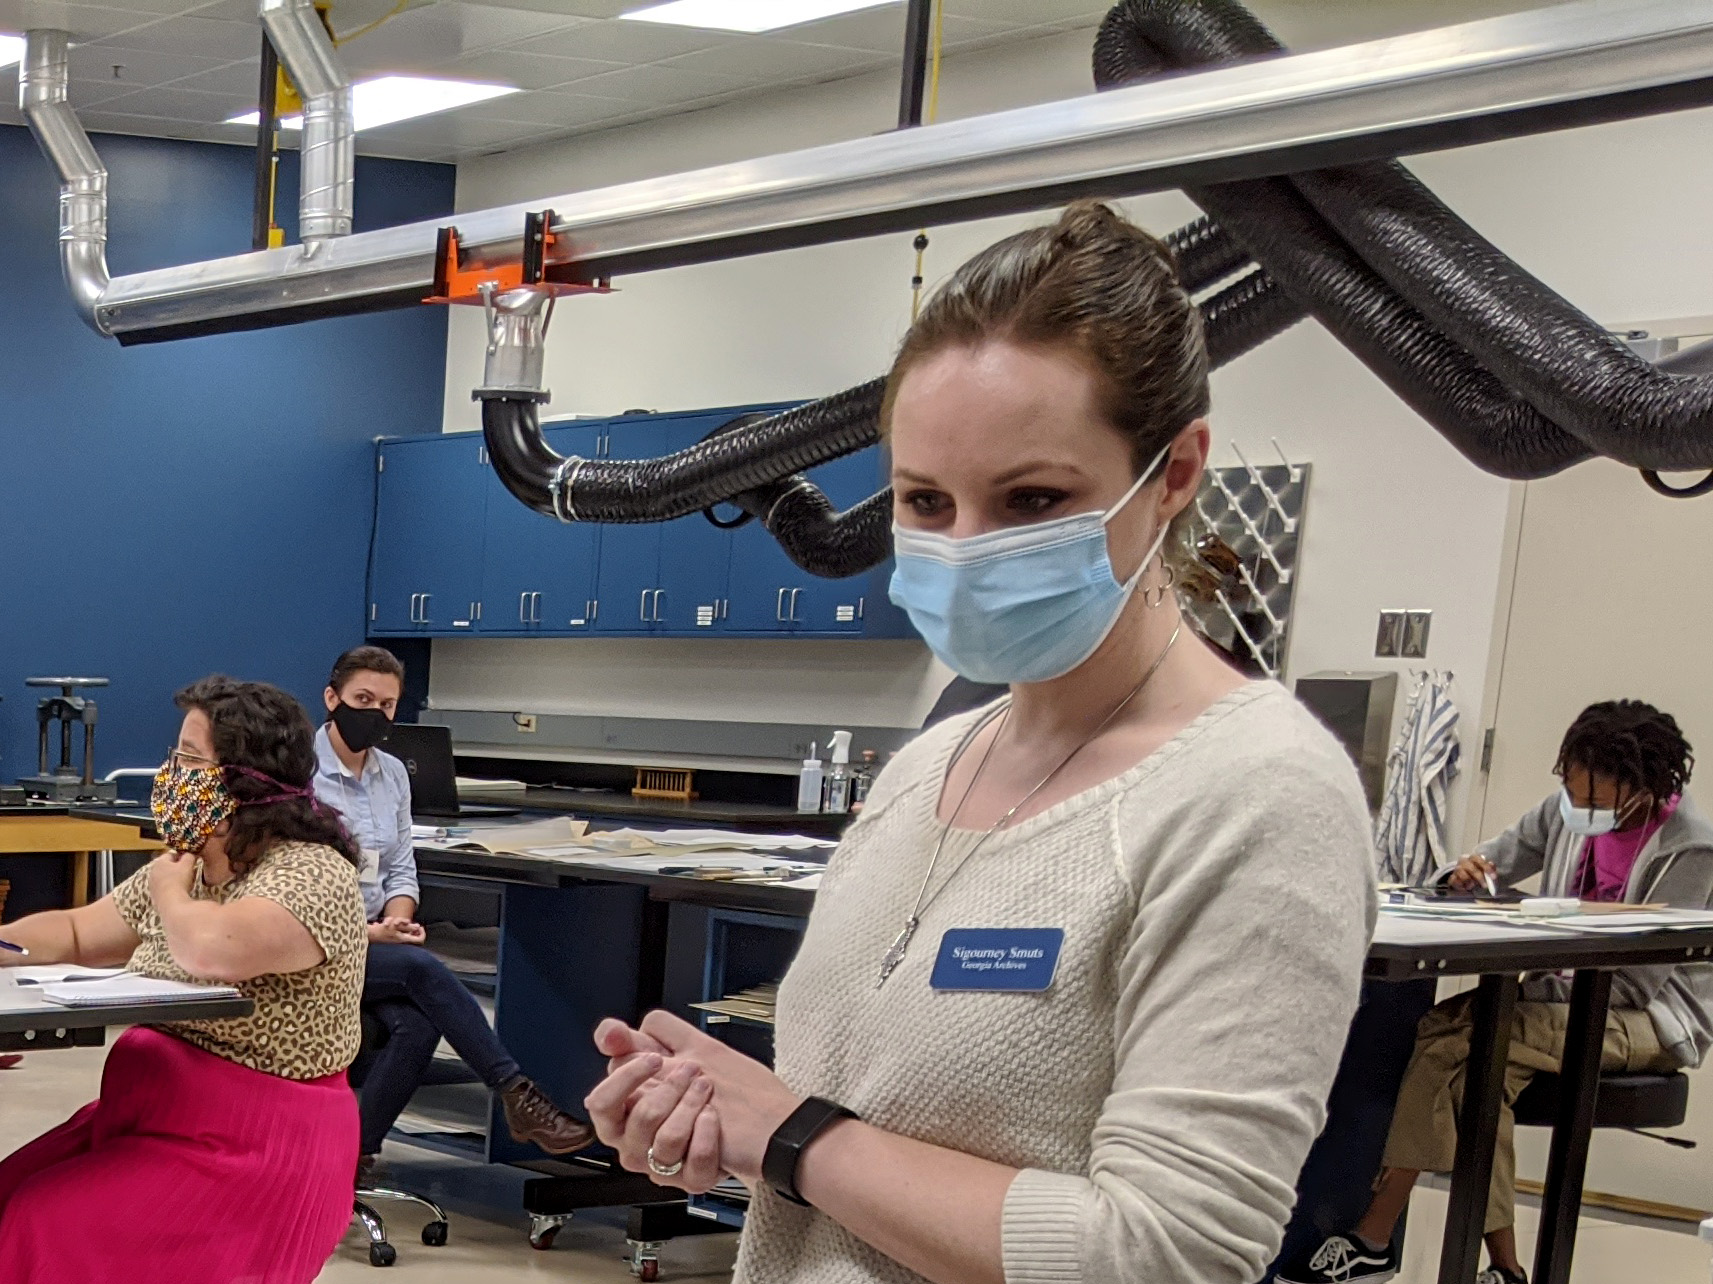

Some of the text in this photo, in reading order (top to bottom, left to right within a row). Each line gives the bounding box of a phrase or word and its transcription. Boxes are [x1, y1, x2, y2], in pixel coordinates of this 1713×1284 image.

[952, 946, 1045, 961] Sigourney Smuts
[961, 961, 1027, 971] Georgia Archives
